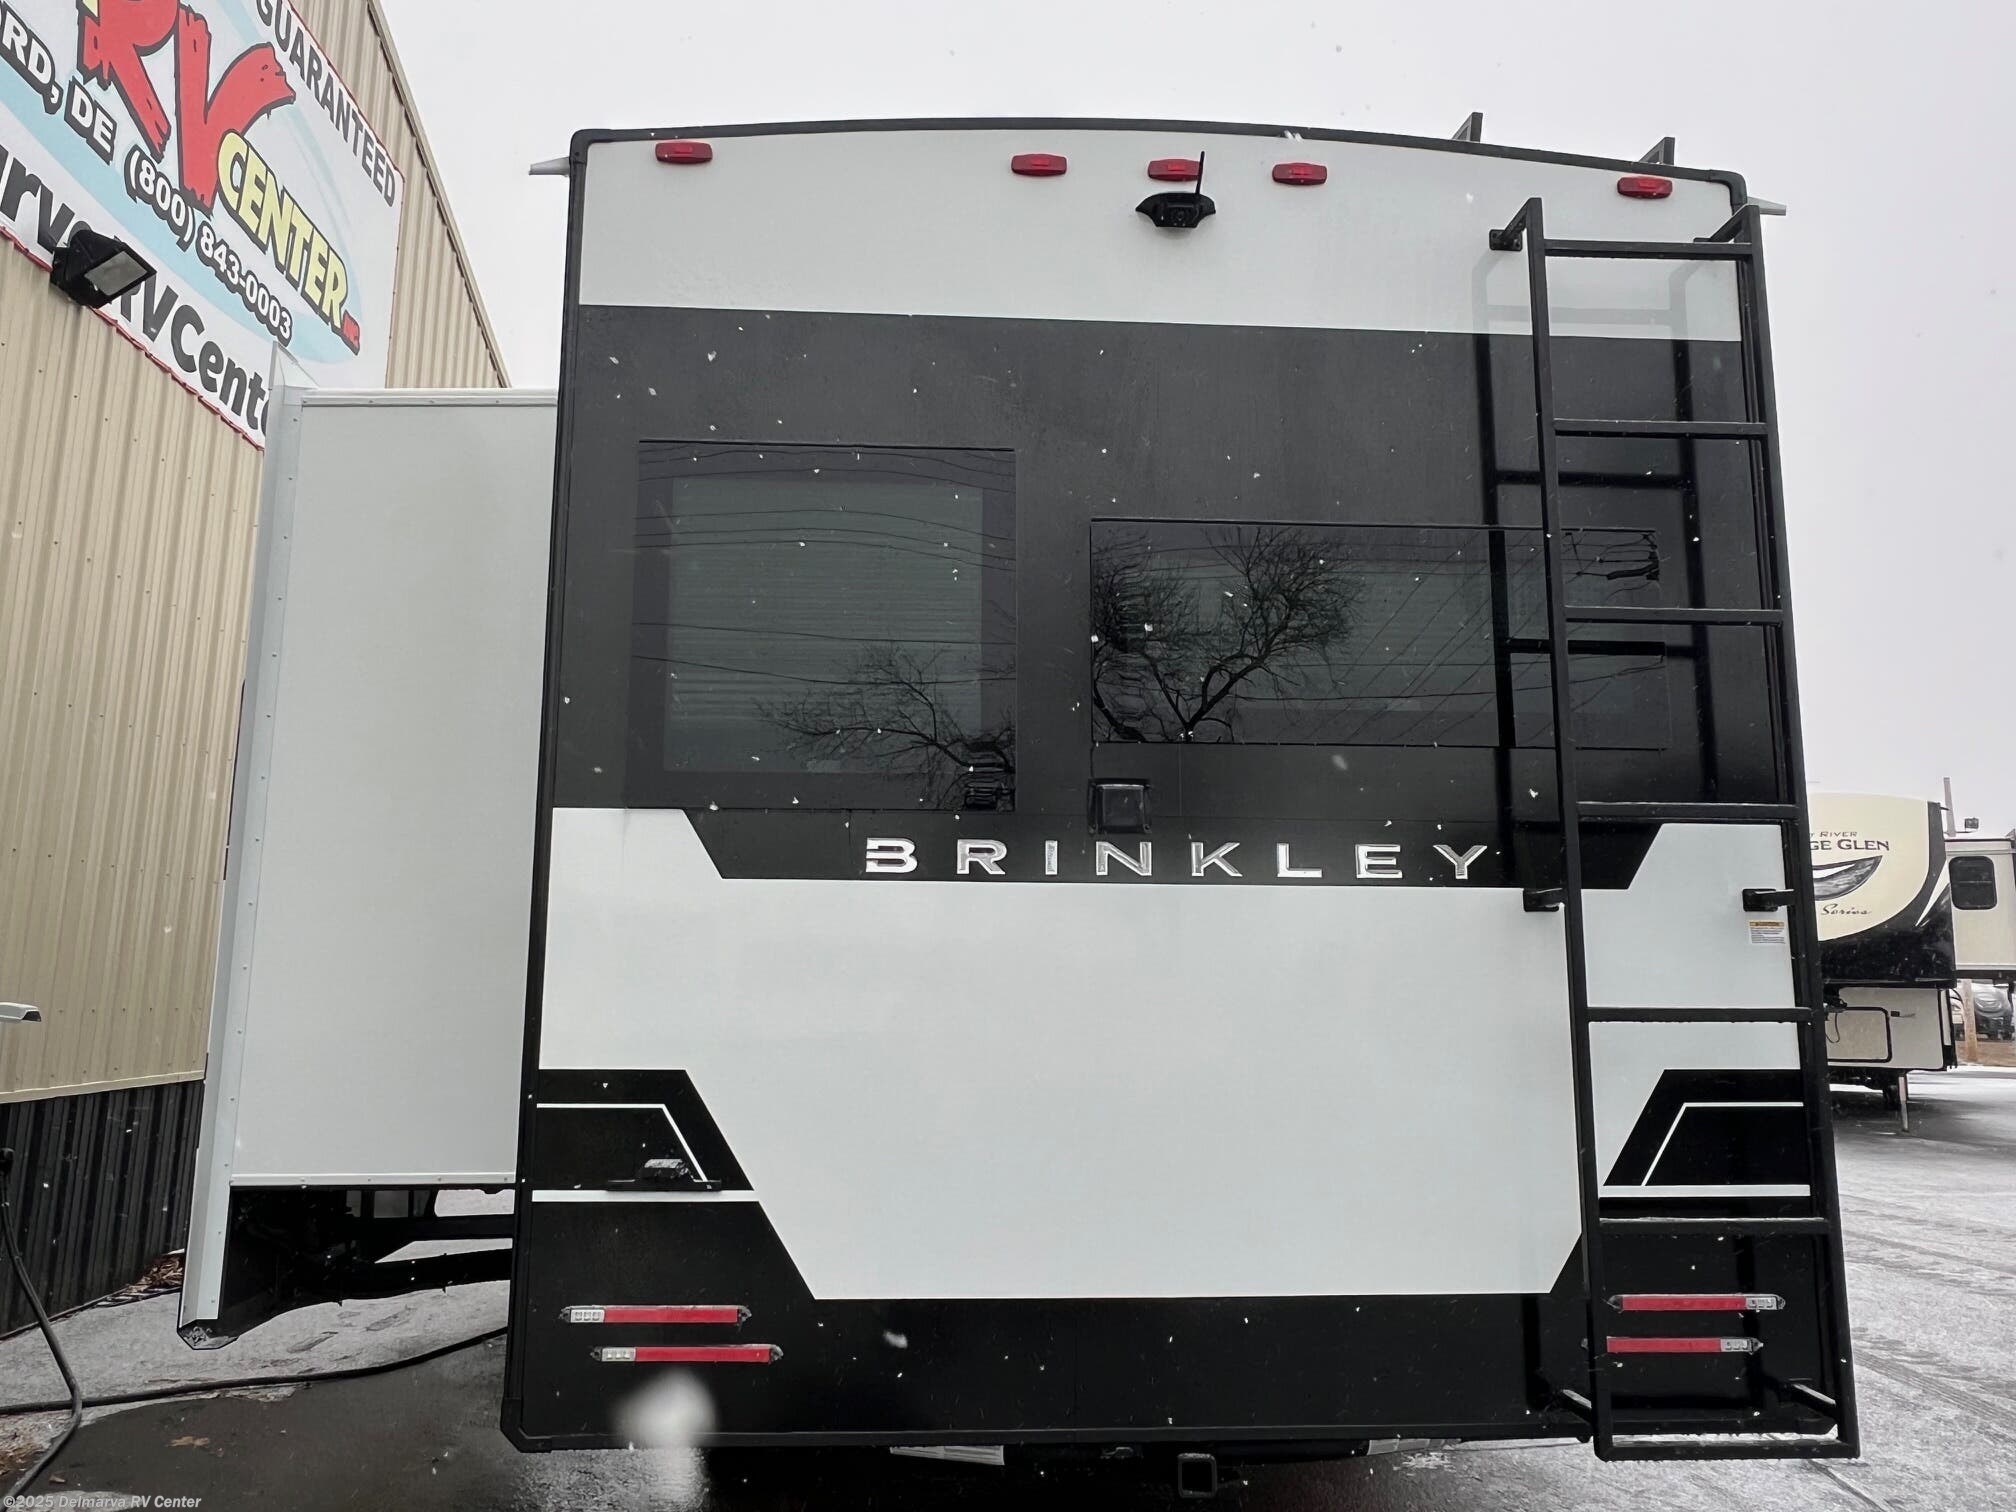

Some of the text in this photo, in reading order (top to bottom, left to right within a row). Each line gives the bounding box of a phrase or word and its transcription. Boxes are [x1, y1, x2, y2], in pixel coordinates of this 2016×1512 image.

[68, 82, 115, 156] DE
[128, 148, 195, 245] (800)
[199, 223, 293, 344] 843-0003
[217, 129, 349, 331] CENTER
[865, 837, 1488, 880] BRINKLEY
[1837, 838, 1890, 851] GLEN
